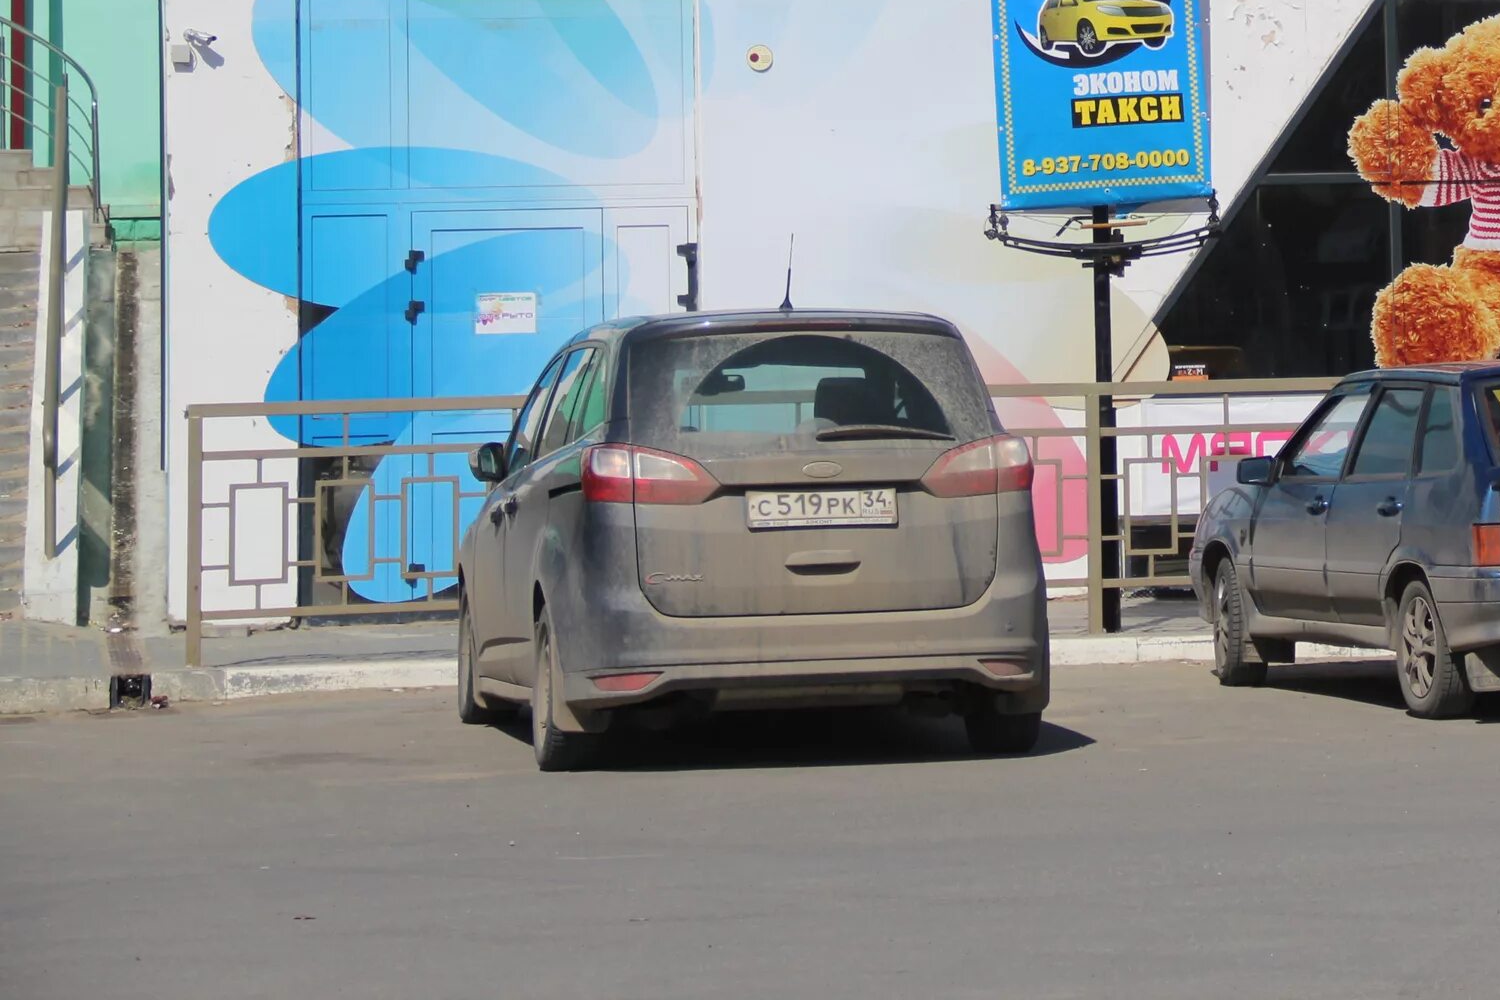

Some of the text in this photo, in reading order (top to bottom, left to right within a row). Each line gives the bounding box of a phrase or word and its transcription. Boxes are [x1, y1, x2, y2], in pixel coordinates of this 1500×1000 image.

[1073, 69, 1179, 96] ЭКОНОМ
[1074, 95, 1182, 125] ТАКСИ
[1022, 149, 1190, 176] 8-937-708-0000
